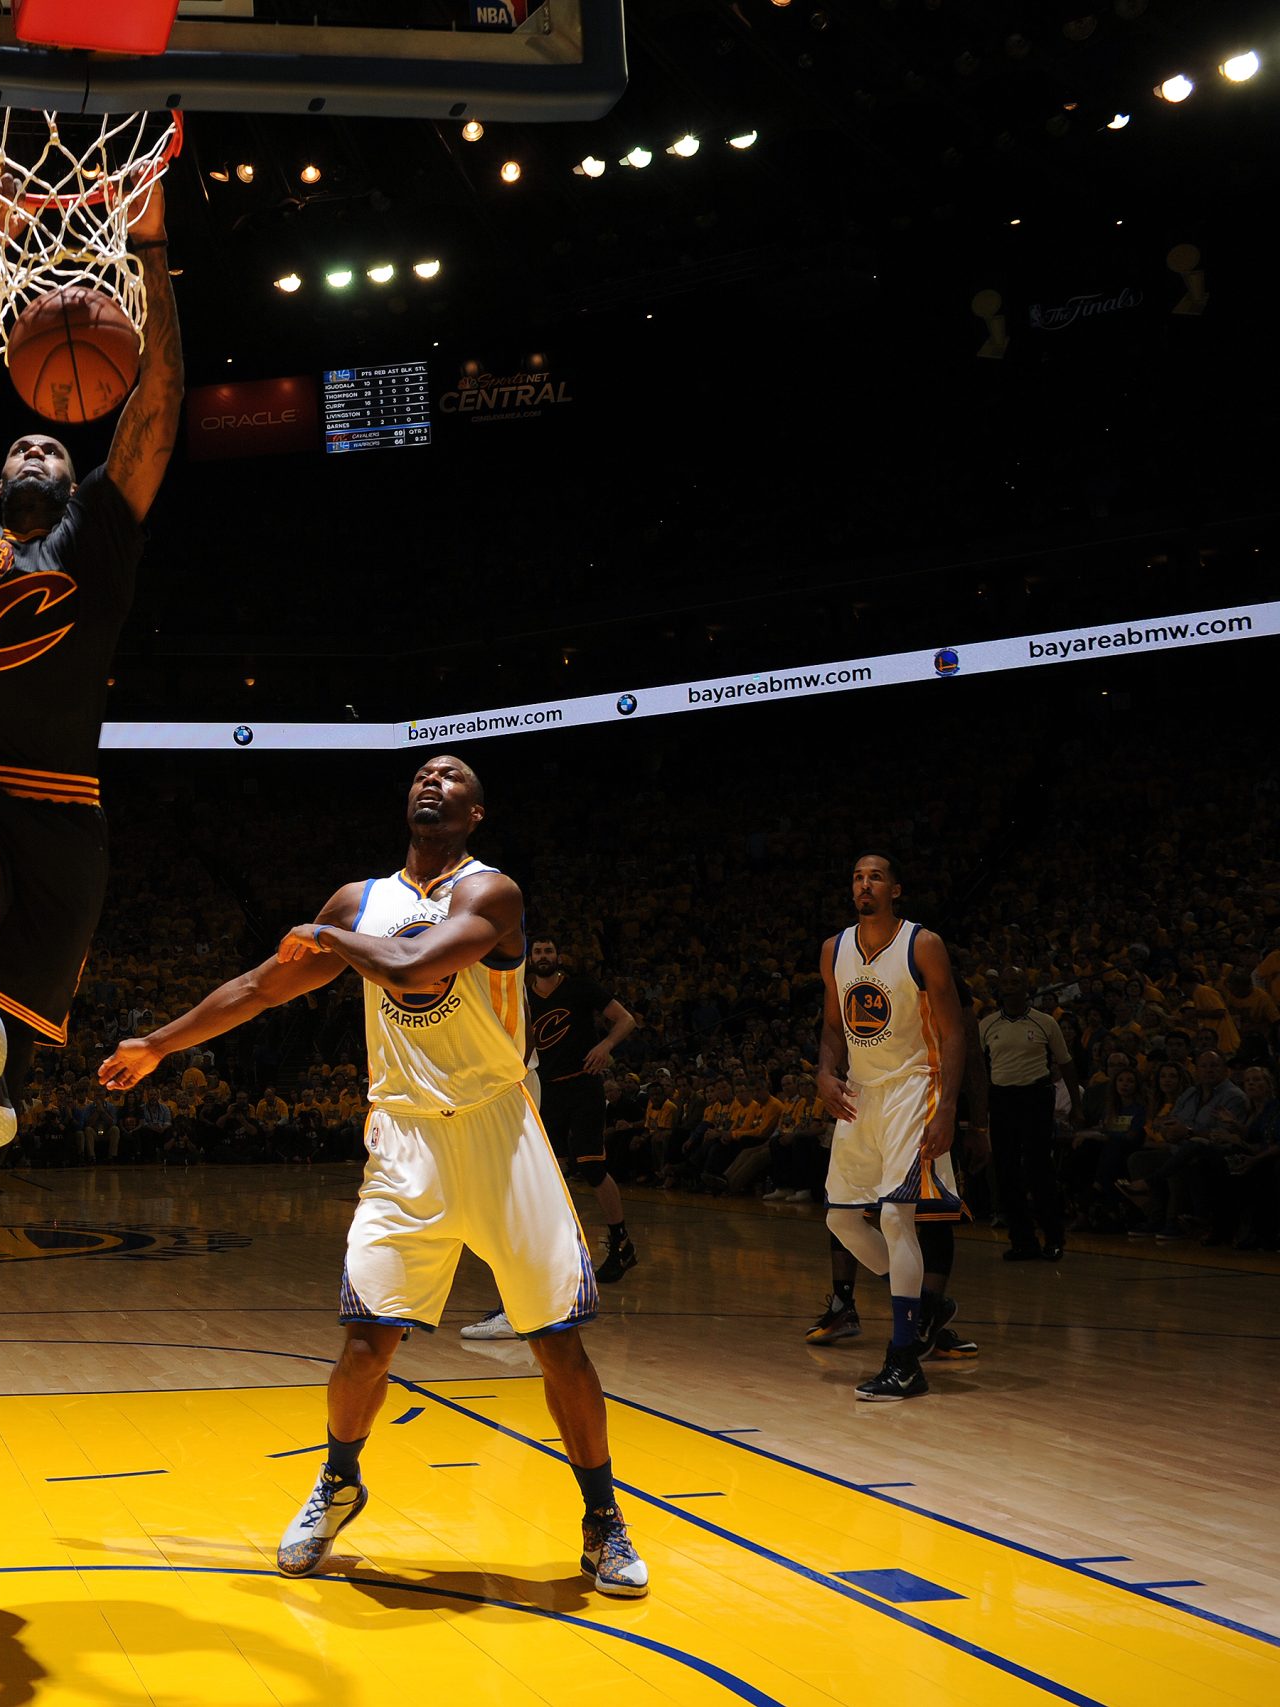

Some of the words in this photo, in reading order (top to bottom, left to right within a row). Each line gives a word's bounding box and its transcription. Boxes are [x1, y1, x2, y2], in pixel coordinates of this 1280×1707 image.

[476, 6, 509, 25] NBA
[1064, 286, 1144, 322] Finals
[325, 382, 355, 390] IGUODALA
[325, 391, 358, 400] THOMPSON
[439, 380, 575, 414] CENTRAL
[200, 408, 298, 431] ORACLE
[326, 412, 361, 420] LIVINGSTON
[326, 422, 350, 430] BARNES
[351, 431, 380, 440] CAVALIERS
[1028, 614, 1253, 659] bayareabmw.com
[687, 666, 872, 704] bayareabmw.com
[407, 708, 563, 741] bayareabmw.com
[843, 975, 870, 994] GOLDEN
[871, 977, 893, 995] STATE
[380, 994, 462, 1029] WARRIORS
[864, 993, 884, 1010] 34
